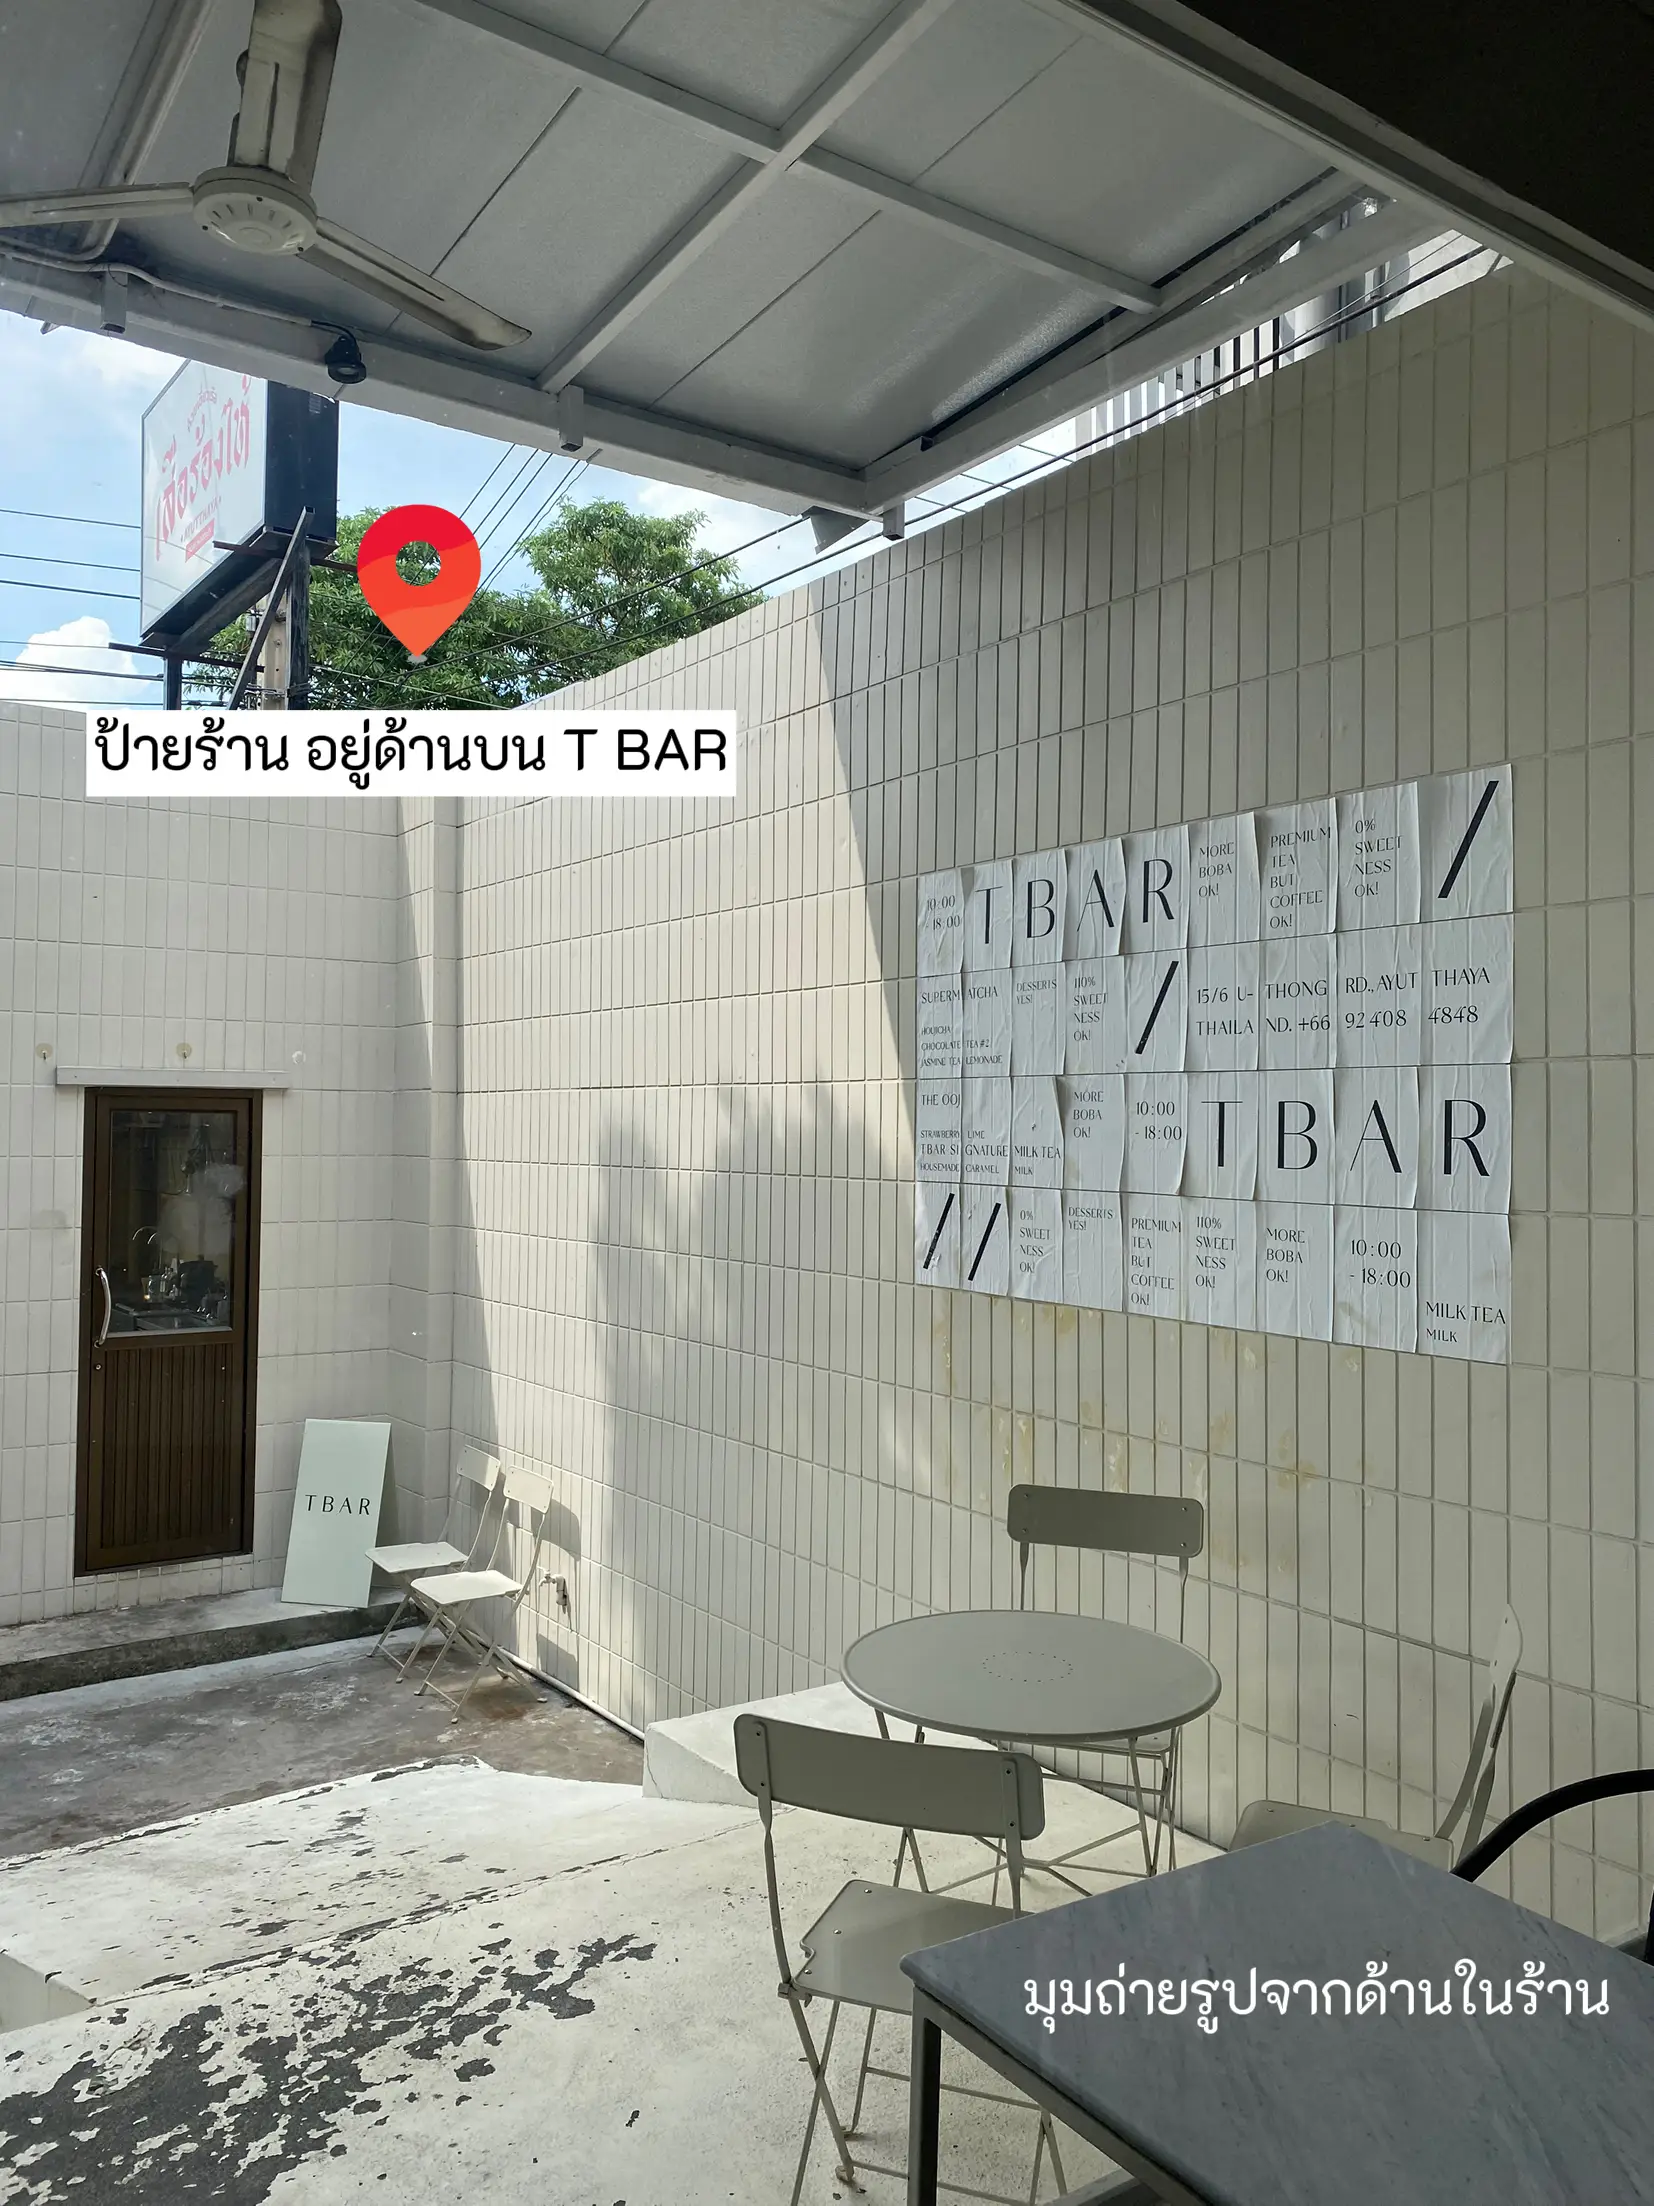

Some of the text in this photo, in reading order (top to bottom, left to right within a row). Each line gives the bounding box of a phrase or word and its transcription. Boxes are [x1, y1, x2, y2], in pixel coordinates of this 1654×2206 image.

[1355, 819, 1376, 834] 0%
[1270, 826, 1331, 849] PREMIUM
[1199, 841, 1235, 859] MORE
[1355, 835, 1404, 856] SWEET
[1272, 853, 1295, 868] TEA
[1355, 858, 1392, 875] NESS
[1199, 862, 1233, 879] BOBA
[1270, 873, 1294, 889] BUT
[1198, 882, 1220, 898] OK!
[1354, 881, 1380, 898] OK!
[1270, 889, 1323, 909] COFFEE
[1269, 913, 1293, 929] OK!
[1016, 978, 1057, 992] DESSERTS
[1016, 994, 1033, 1005] YES!
[1073, 993, 1108, 1007] SWEET
[1196, 986, 1228, 1004] 15/6
[1073, 1011, 1101, 1023] NESS
[1428, 1004, 1479, 1025] 4848
[1073, 1029, 1091, 1042] OK!
[965, 1039, 979, 1049] TEA
[965, 1055, 1003, 1065] LEMONADE
[921, 1094, 939, 1106] THE
[1074, 1091, 1104, 1103] MORE
[1073, 1109, 1102, 1120] BOBA
[1136, 1101, 1175, 1116] 10:00
[920, 1130, 985, 1139] STRAWBERRY LIME
[1073, 1126, 1091, 1138] OK!
[1144, 1125, 1182, 1140] 18:00
[920, 1143, 946, 1156] TBAR
[1014, 1145, 1038, 1158] MILK
[1041, 1146, 1061, 1159] TEA
[920, 1163, 1033, 1175] HOUSEMADE CARAMEL MILK
[1020, 1209, 1033, 1220] 0%
[1068, 1206, 1113, 1219] DESSERTS
[1068, 1220, 1087, 1231] YES!
[1131, 1217, 1182, 1233] PREMIUM
[1019, 1226, 1051, 1240] SWEET
[1266, 1227, 1306, 1244] MORE
[1132, 1236, 1152, 1249] TEA
[1195, 1235, 1236, 1251] SWEET
[1351, 1239, 1402, 1259] 10:00
[1020, 1244, 1044, 1257] NESS
[1266, 1248, 1303, 1264] BOBA
[1019, 1261, 1035, 1273] OK!
[1131, 1255, 1151, 1268] BUT
[1196, 1255, 1226, 1270] NESS
[1131, 1273, 1175, 1290] COFFEE
[1195, 1274, 1216, 1289] OK!
[1266, 1269, 1289, 1283] OK!
[1362, 1268, 1411, 1288] 18:00
[1130, 1292, 1150, 1306] OK!
[1426, 1301, 1506, 1325] MILK TEA
[1426, 1328, 1458, 1343] MILK
[305, 1494, 371, 1515] TBAR
